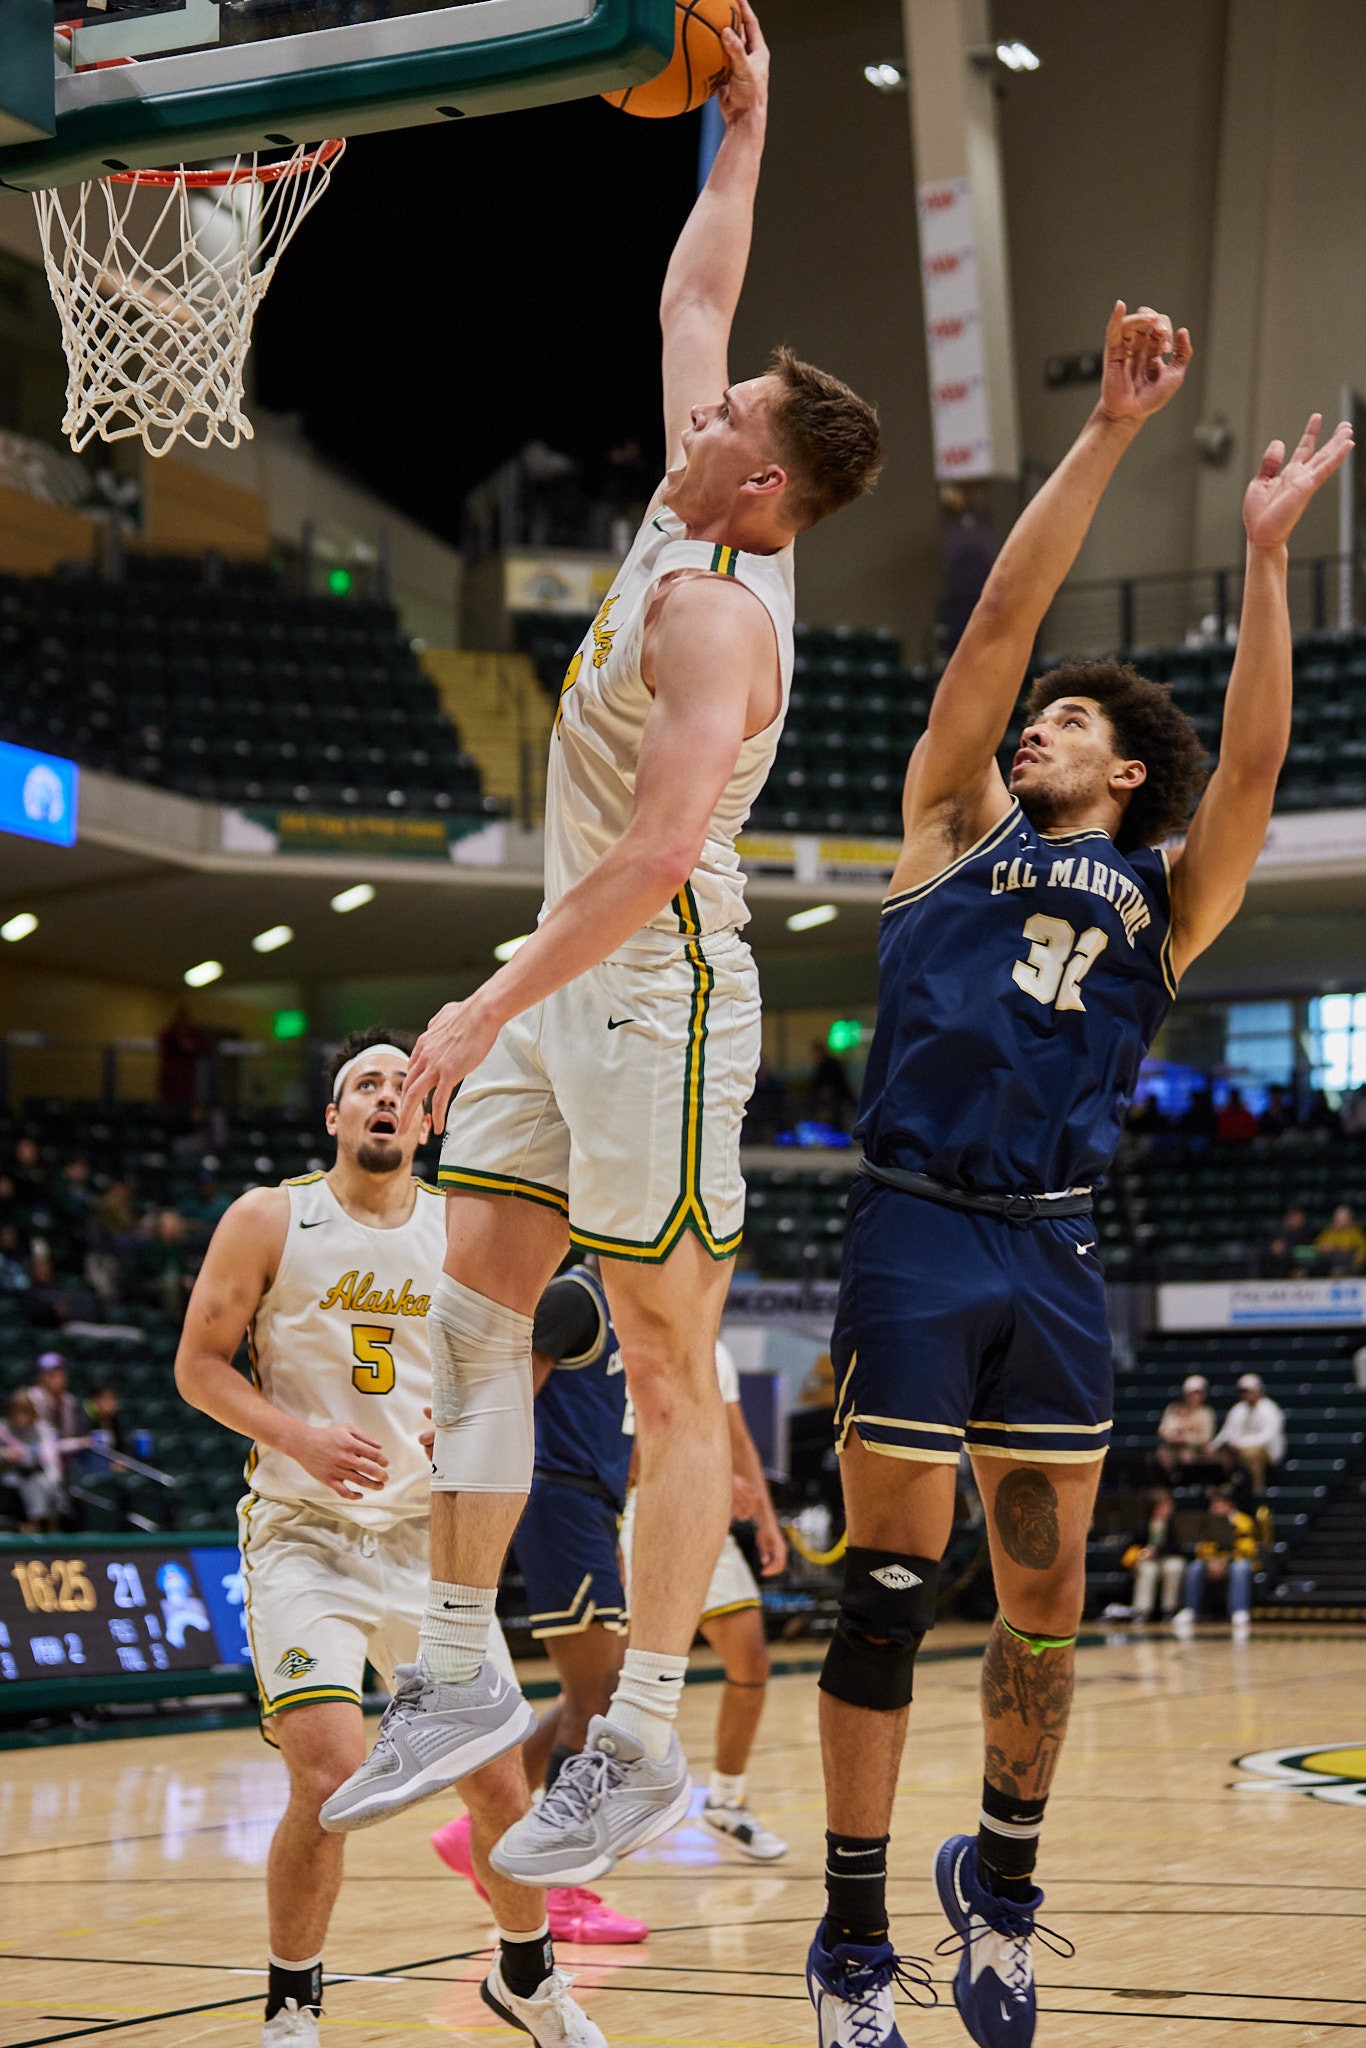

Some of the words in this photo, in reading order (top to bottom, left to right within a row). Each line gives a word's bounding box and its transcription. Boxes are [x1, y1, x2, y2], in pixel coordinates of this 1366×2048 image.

[990, 857, 1038, 896] CAL
[1046, 856, 1151, 949] MARITIME
[1011, 912, 1109, 1012] 32
[319, 1270, 431, 1317] Alaska
[351, 1323, 396, 1395] 5
[11, 1560, 98, 1613] 16:25
[107, 1562, 147, 1608] 21
